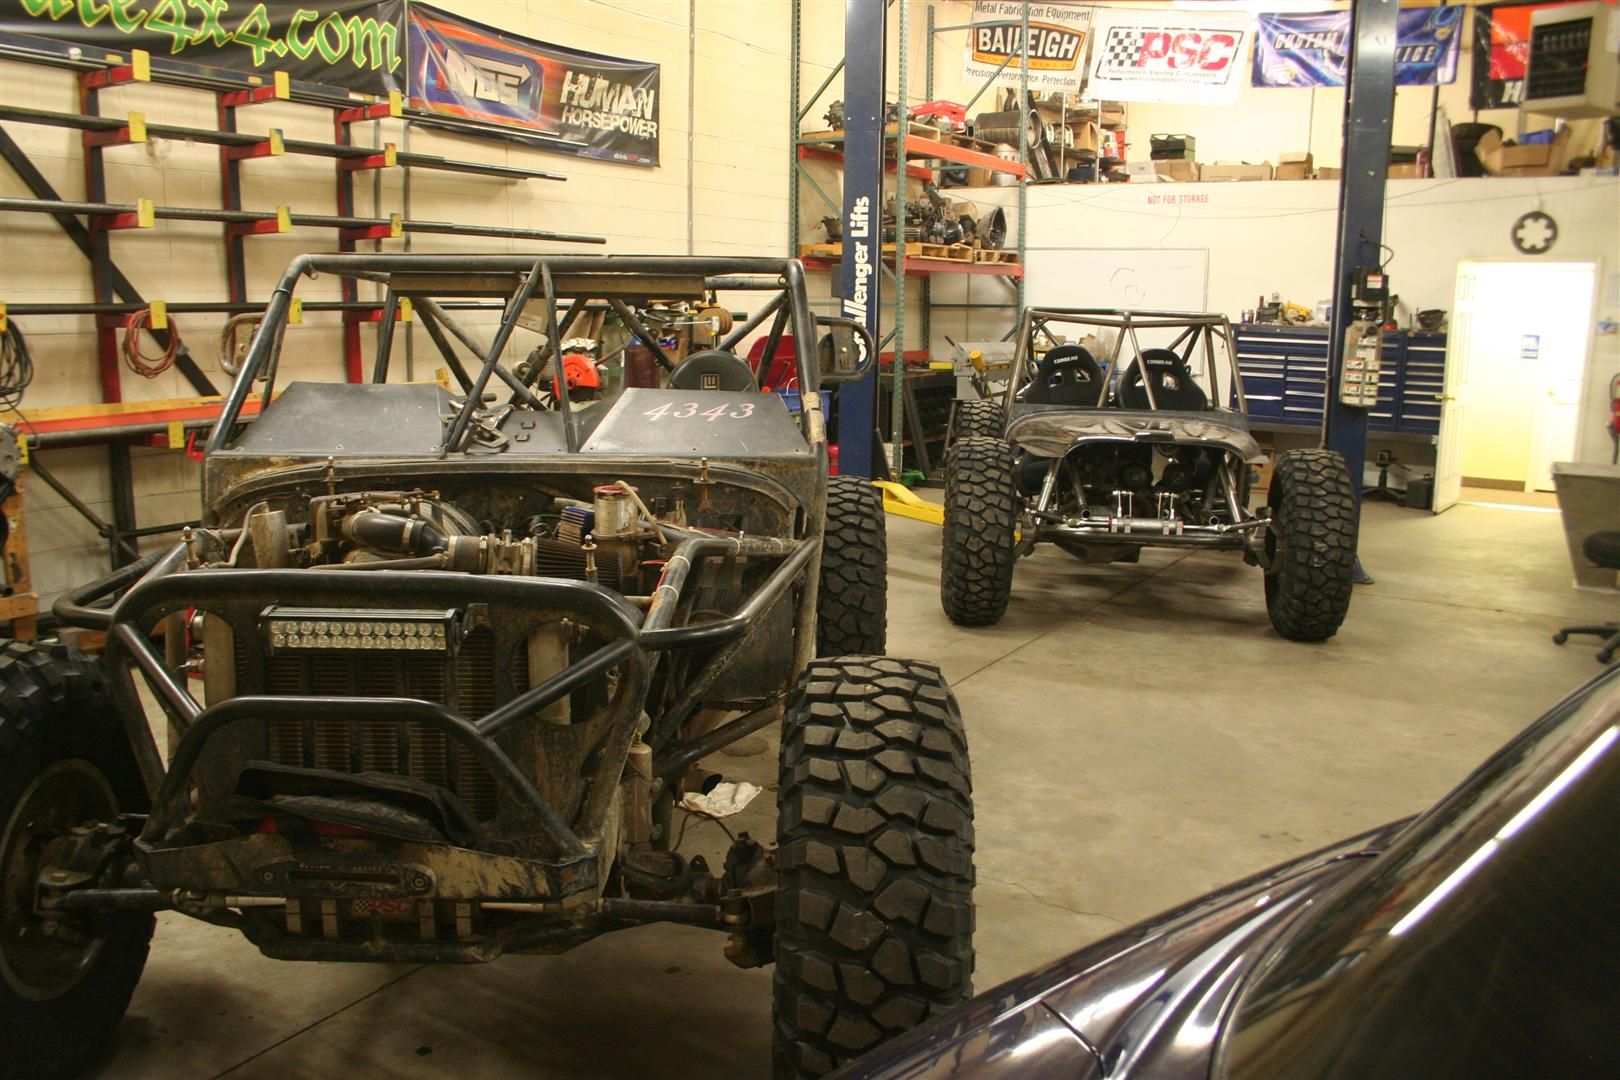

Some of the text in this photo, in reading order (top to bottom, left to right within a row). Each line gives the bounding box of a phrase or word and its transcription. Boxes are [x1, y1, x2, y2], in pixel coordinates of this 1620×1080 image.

[975, 1, 1090, 21] Metal Fabriction Equipment
[978, 26, 1079, 59] BAILEIGH
[1138, 31, 1235, 70] PSC
[560, 70, 655, 119] HUMAN
[561, 106, 658, 138] HORSEPOWER
[1147, 193, 1209, 205] NOT FOR STORAGE
[849, 196, 870, 238] Lifts
[642, 402, 756, 422] 4343
